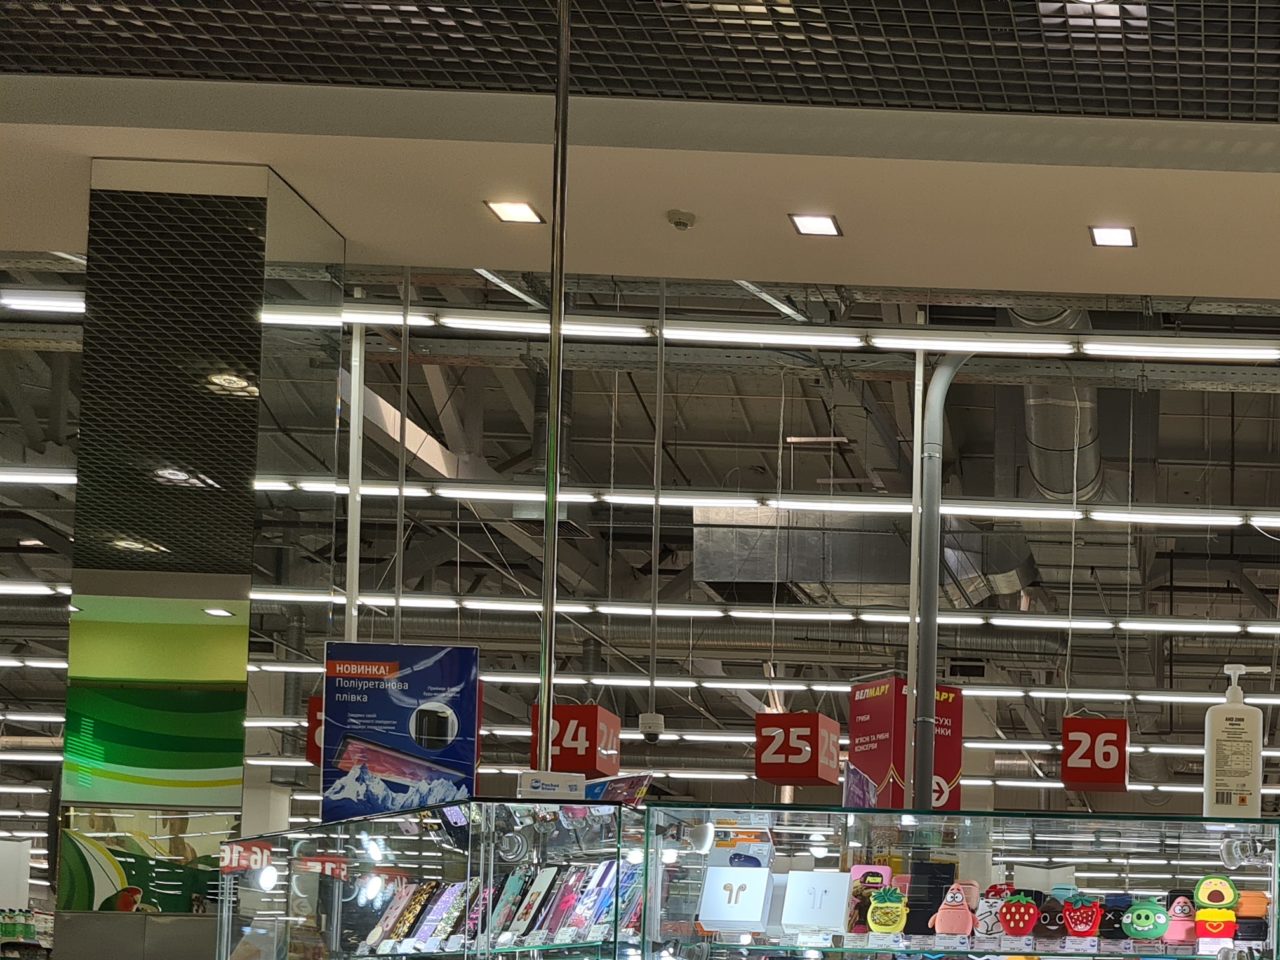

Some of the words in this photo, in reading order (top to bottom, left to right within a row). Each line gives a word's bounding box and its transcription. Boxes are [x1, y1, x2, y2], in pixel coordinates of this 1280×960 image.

[336, 663, 389, 676] НОВИНКА!
[335, 677, 409, 690] Поліуретанова
[335, 692, 368, 703] плівка
[854, 684, 890, 701] ВЕЛМАРТ
[760, 726, 812, 763] 25
[819, 728, 838, 769] 25
[1066, 731, 1119, 769] 26
